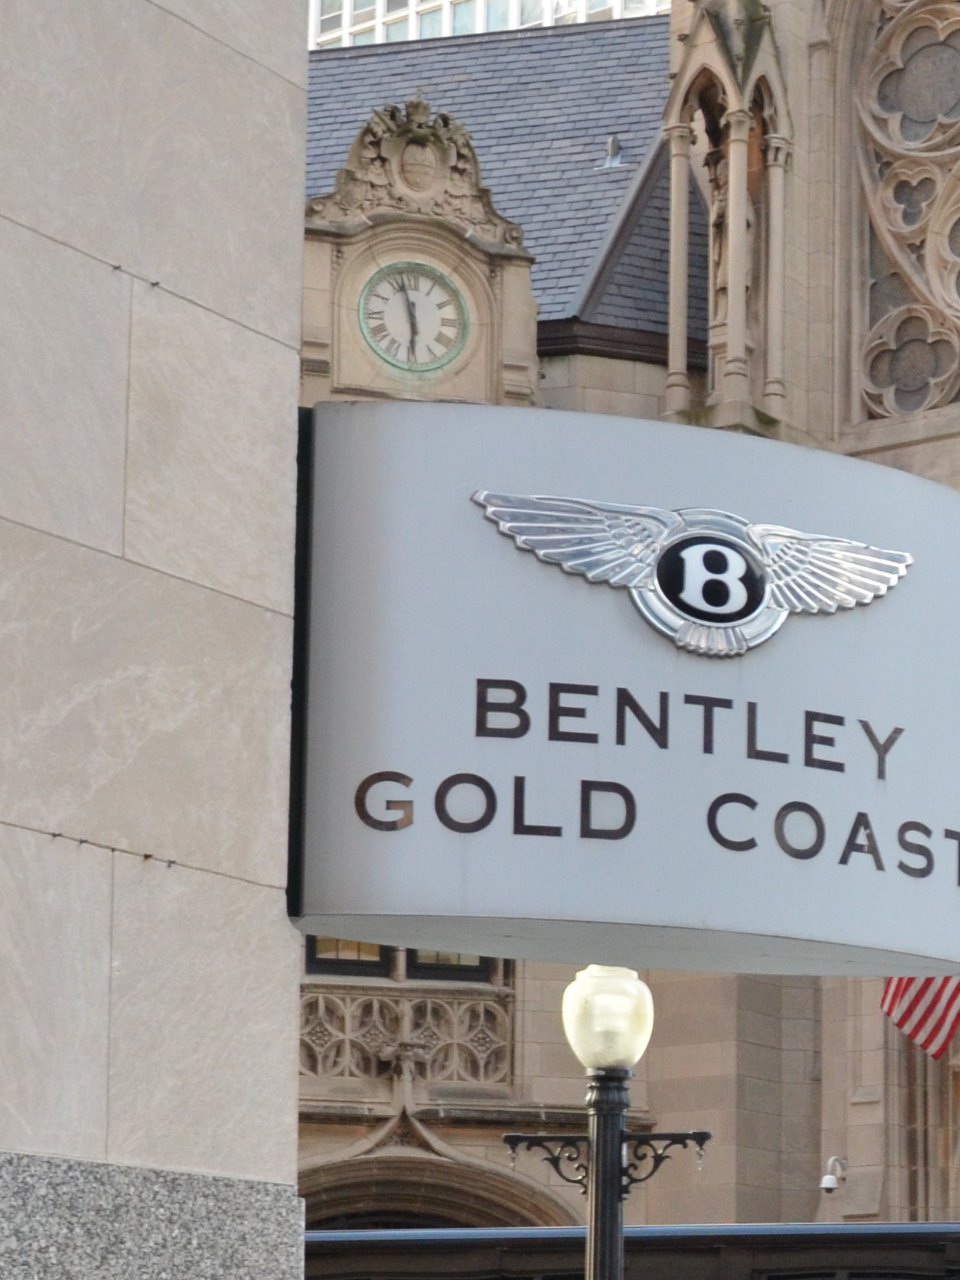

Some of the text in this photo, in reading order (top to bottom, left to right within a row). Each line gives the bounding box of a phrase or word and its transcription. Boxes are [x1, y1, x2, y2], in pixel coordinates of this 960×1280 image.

[678, 542, 750, 615] B
[474, 678, 905, 780] BENTLEY
[353, 770, 637, 841] GOLD
